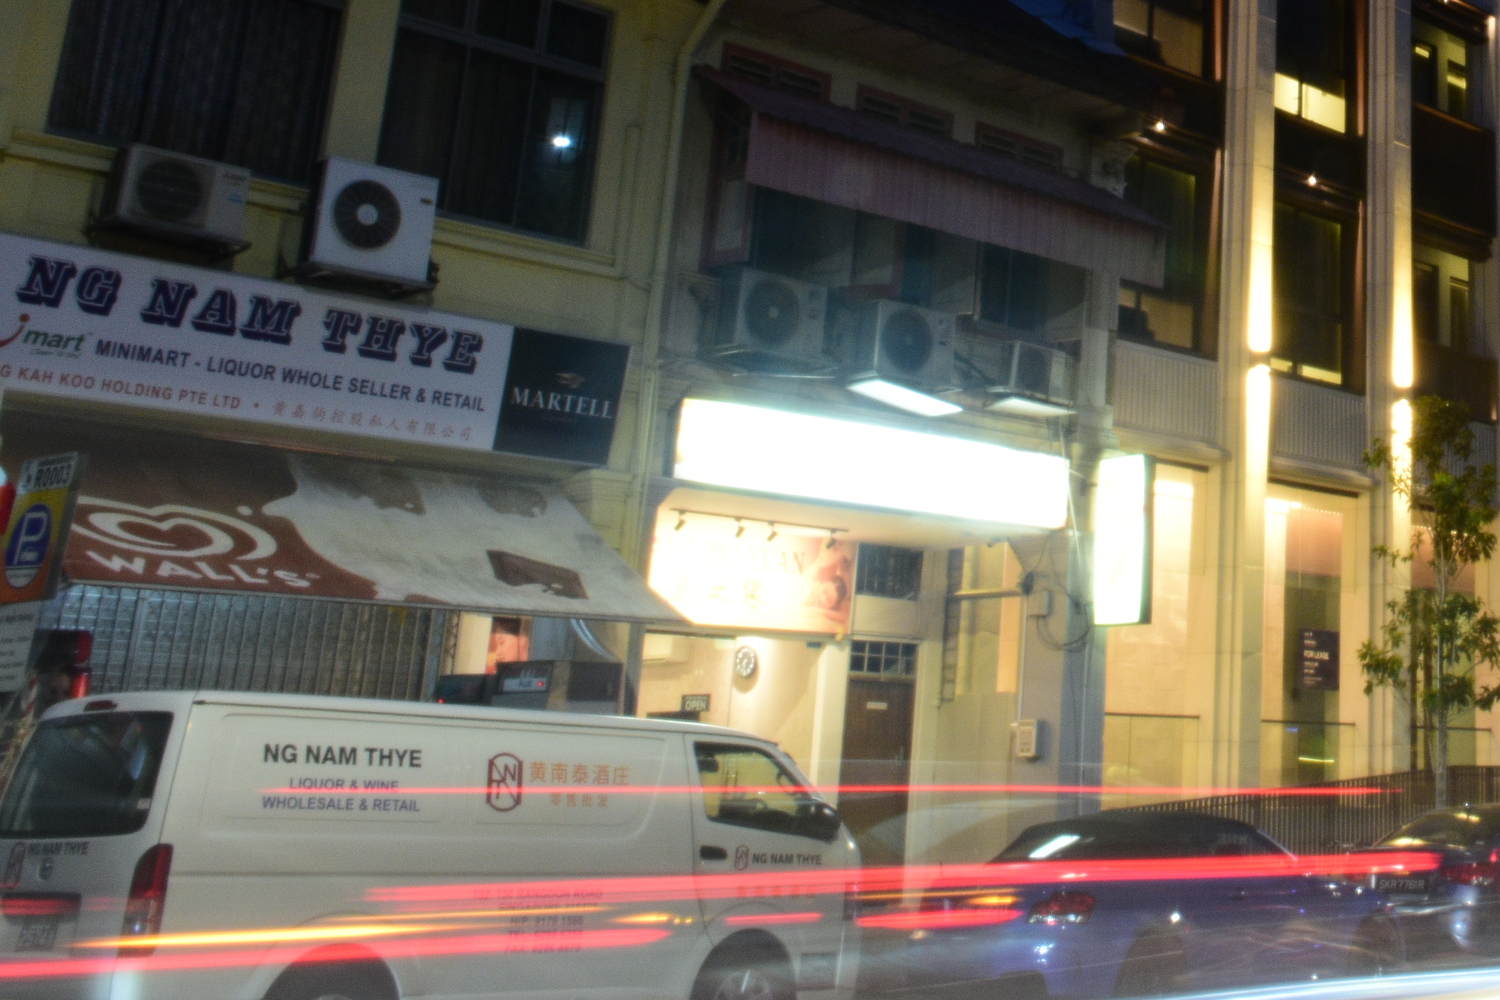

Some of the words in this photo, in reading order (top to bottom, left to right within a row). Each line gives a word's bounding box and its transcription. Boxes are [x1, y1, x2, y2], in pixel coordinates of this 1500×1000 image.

[16, 255, 122, 316] NG
[140, 276, 302, 346] NAM
[321, 306, 485, 375] THYE
[18, 364, 54, 382] KAH
[59, 372, 96, 389] KOO
[101, 378, 173, 400] HOLDING
[178, 389, 208, 405] PTE
[213, 394, 241, 409] LTD
[95, 339, 191, 368] MINIMART
[207, 356, 275, 380] LIQUOR
[282, 367, 343, 391] WHOLE
[348, 377, 411, 401] SELLER
[415, 388, 427, 403] &
[432, 390, 485, 412] RETAIL
[511, 386, 612, 418] MARTELL
[13, 511, 48, 565] P
[685, 700, 707, 711] OPEN
[263, 743, 297, 763] NG
[305, 745, 357, 765] NAM
[364, 747, 422, 768] THYE
[289, 778, 345, 790] LIQUOR
[363, 780, 399, 792] WINE
[262, 796, 354, 811] WHOLESALE
[358, 798, 368, 811] &
[372, 798, 421, 812] RETAIL
[752, 853, 768, 864] NG
[770, 853, 794, 864] NAM
[796, 853, 822, 865] THYE
